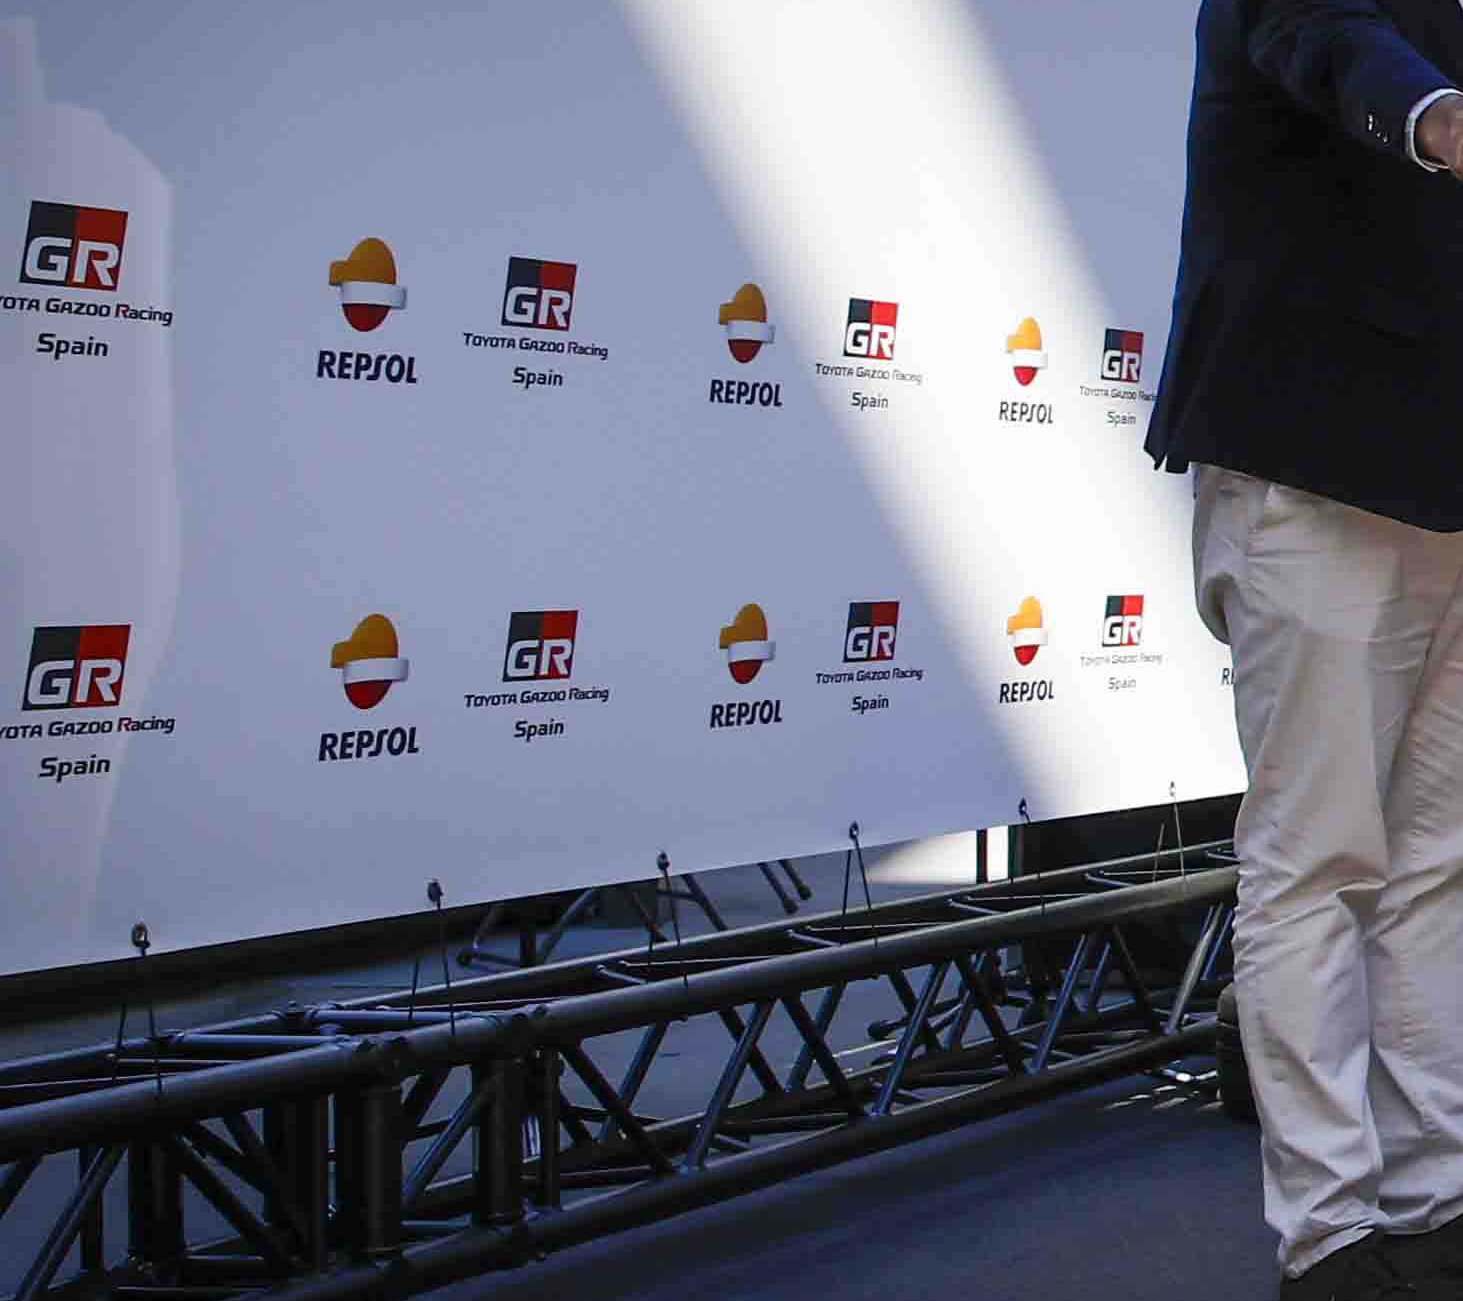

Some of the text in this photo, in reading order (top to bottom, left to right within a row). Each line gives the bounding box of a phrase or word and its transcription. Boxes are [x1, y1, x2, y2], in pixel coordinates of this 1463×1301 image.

[23, 235, 121, 287] GR
[45, 298, 173, 327] GAZOO Racing
[504, 287, 572, 328] GR
[36, 333, 108, 360] Spain
[464, 333, 608, 360] TOYOTA GAZOO Racing
[846, 322, 895, 358] GR
[317, 350, 417, 383] REPSOL
[512, 367, 563, 389] Spain
[1103, 356, 1141, 381] GR
[710, 380, 782, 407] REPSOL
[850, 392, 888, 411] Spain
[999, 401, 1053, 424] REPSOL
[1107, 411, 1136, 427] Spain
[846, 625, 896, 661] GR
[1105, 618, 1142, 646] GR
[505, 640, 573, 679] GR
[27, 659, 122, 708] GR
[1000, 680, 1053, 703] REPSOL
[464, 687, 609, 708] TOYOTA GAZOO Racing
[852, 694, 888, 715] Spain
[710, 700, 782, 728] REPSOL
[0, 716, 175, 741] YOTA GAZOO Racing
[514, 718, 564, 742] Spain
[319, 727, 419, 762] REPSOL
[39, 754, 110, 783] Spain
